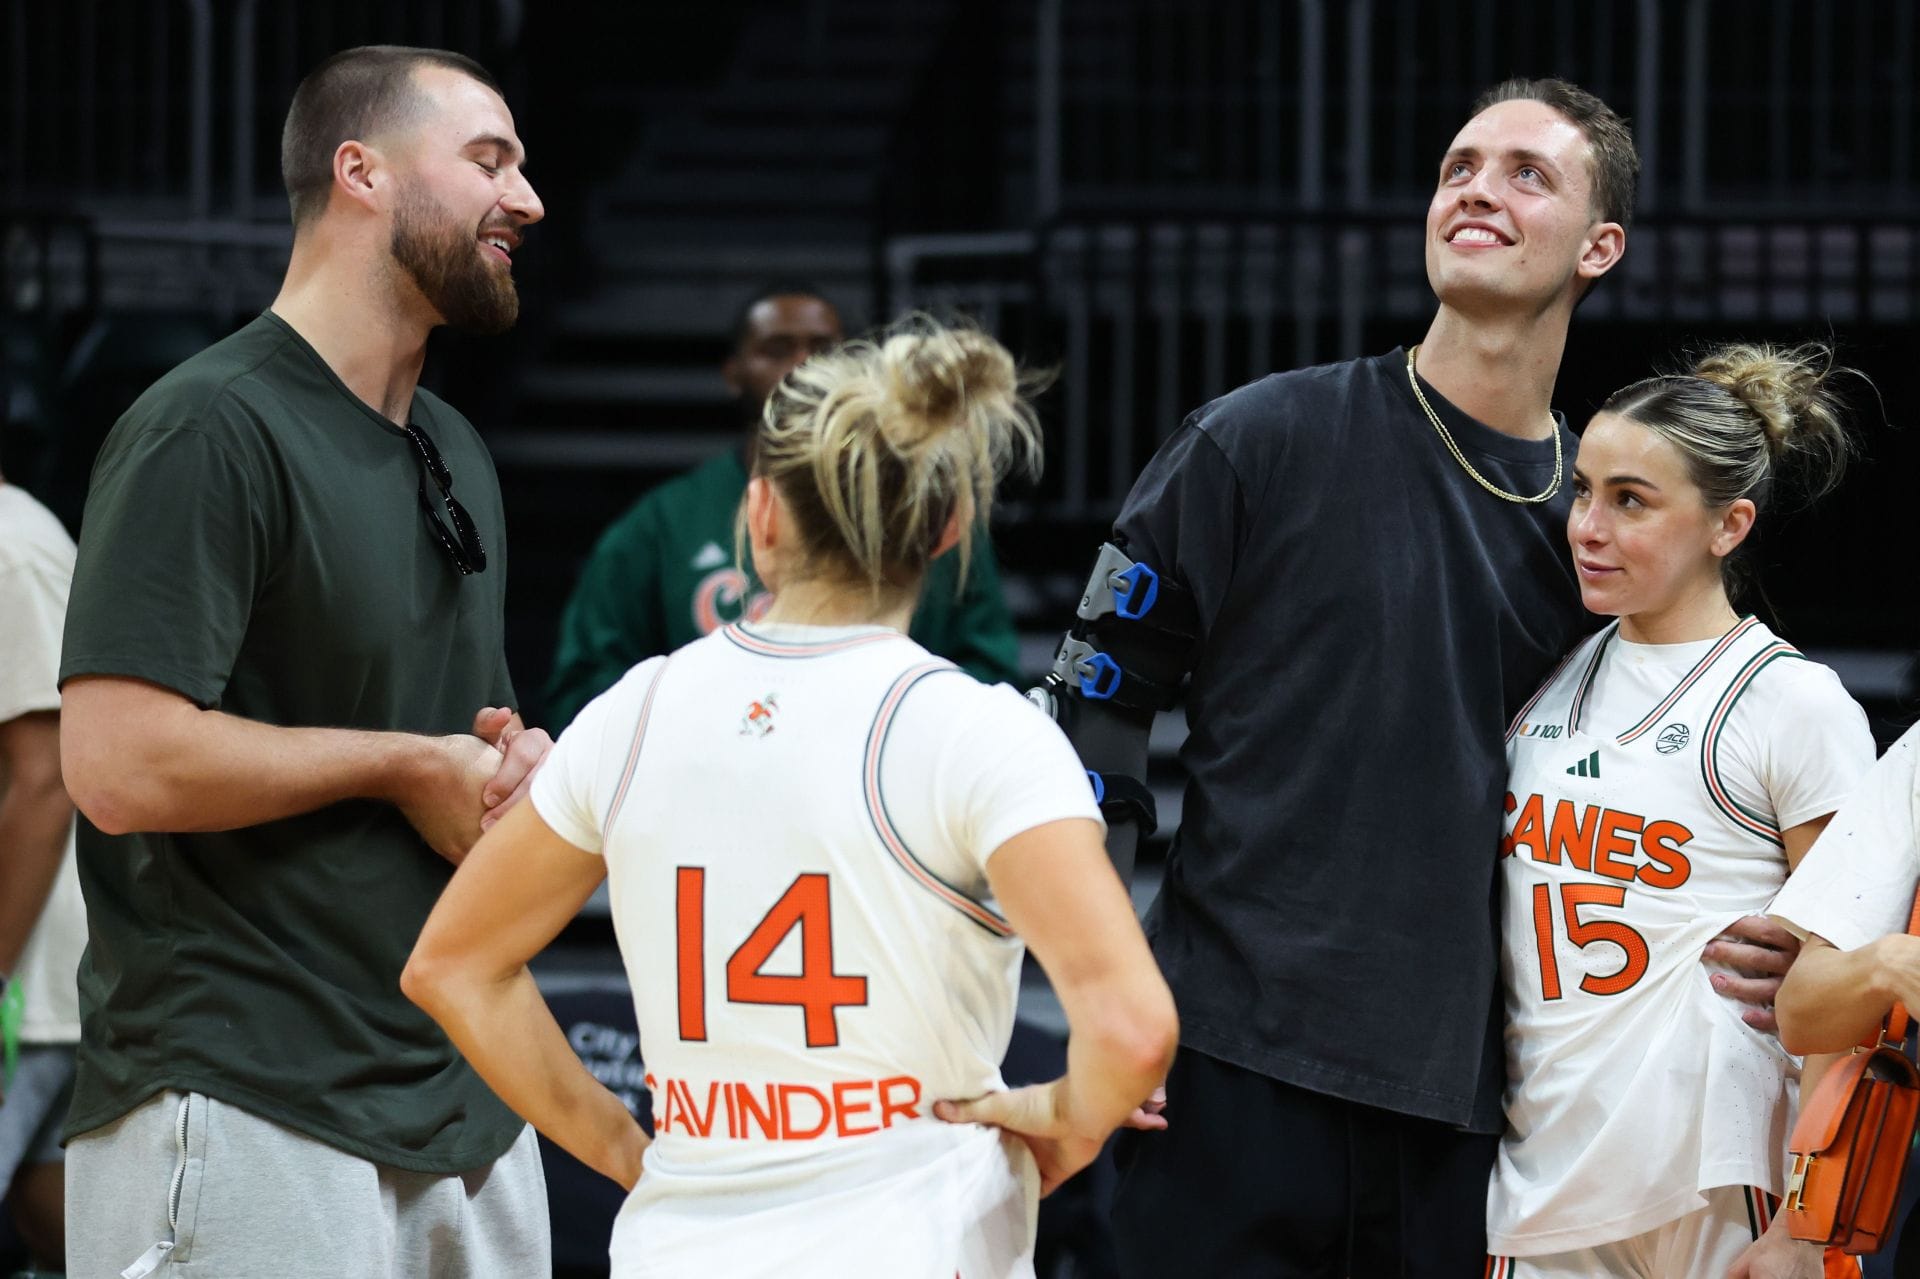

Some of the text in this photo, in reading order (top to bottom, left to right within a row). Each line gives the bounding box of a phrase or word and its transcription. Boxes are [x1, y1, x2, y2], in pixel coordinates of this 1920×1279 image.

[1661, 733, 1689, 743] ACC
[676, 866, 868, 1048] 14
[1533, 883, 1650, 1001] 15
